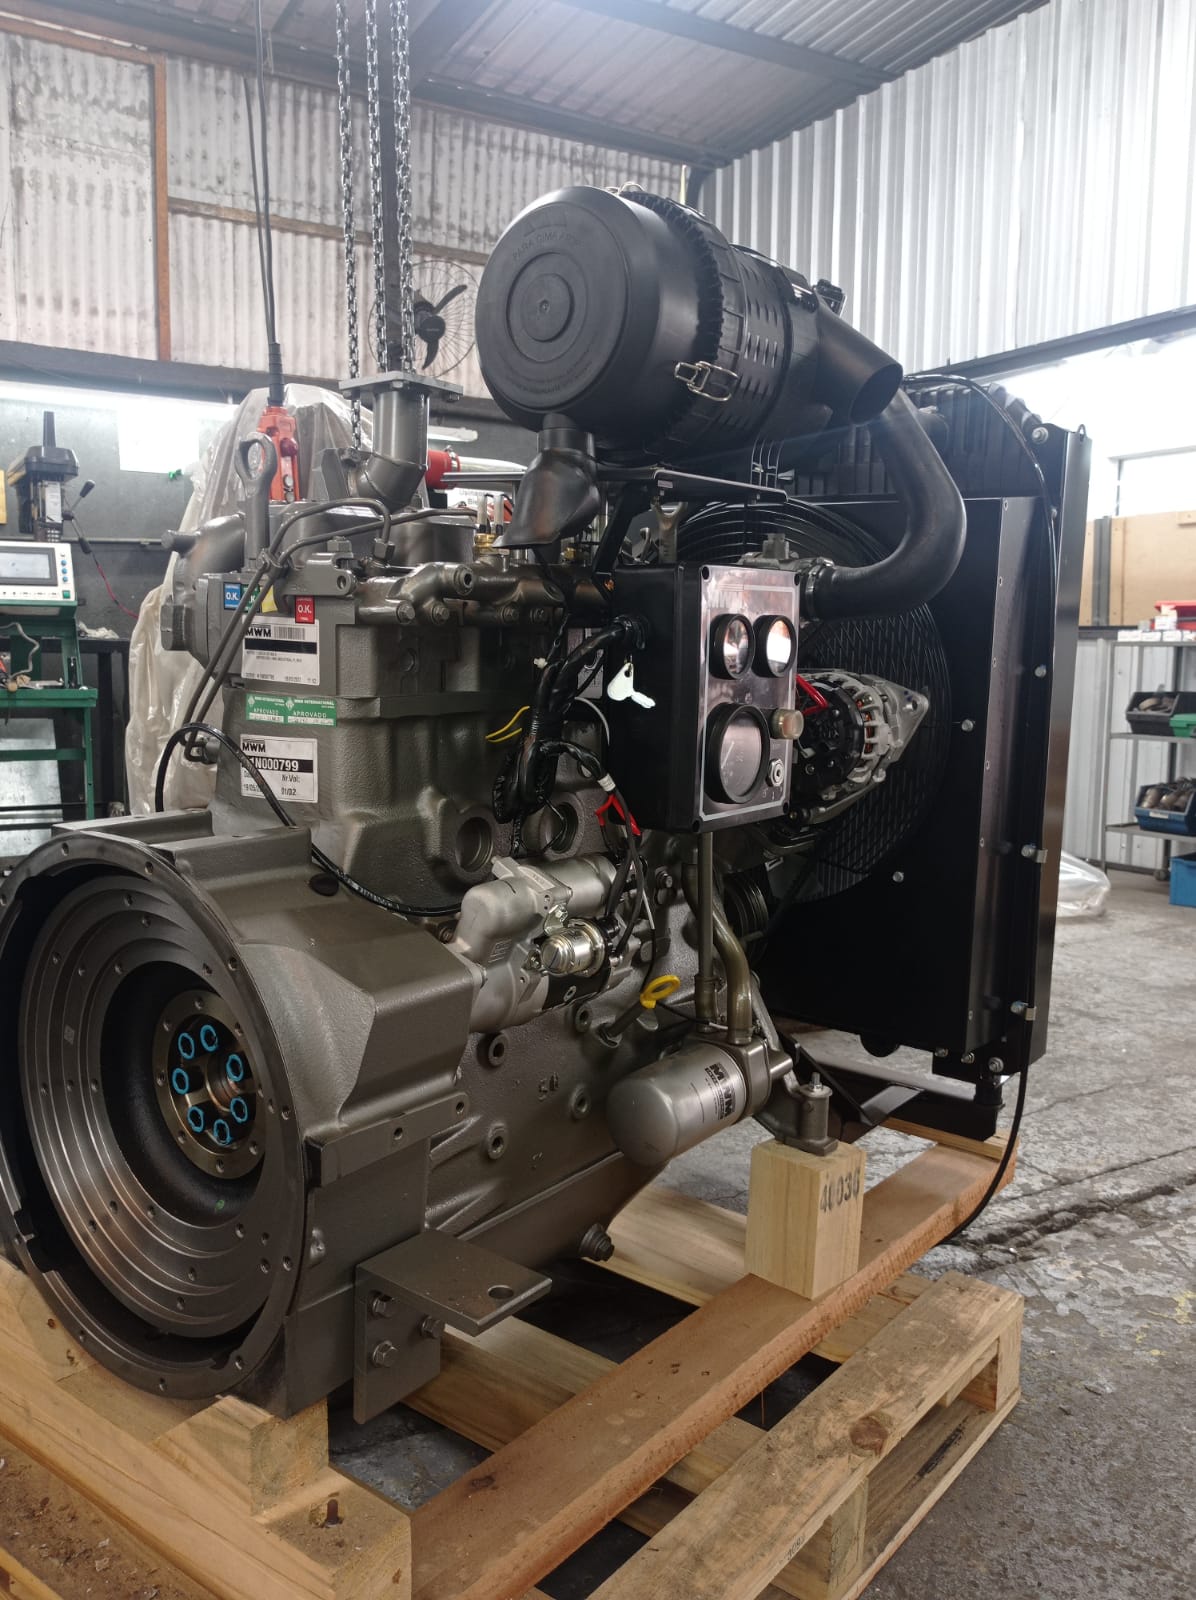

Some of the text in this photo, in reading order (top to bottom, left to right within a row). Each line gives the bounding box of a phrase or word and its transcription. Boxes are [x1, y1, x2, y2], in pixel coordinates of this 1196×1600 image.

[297, 604, 312, 614] O.K.
[246, 627, 271, 637] MWM
[242, 743, 266, 753] MWM
[248, 757, 299, 772] 1N000799
